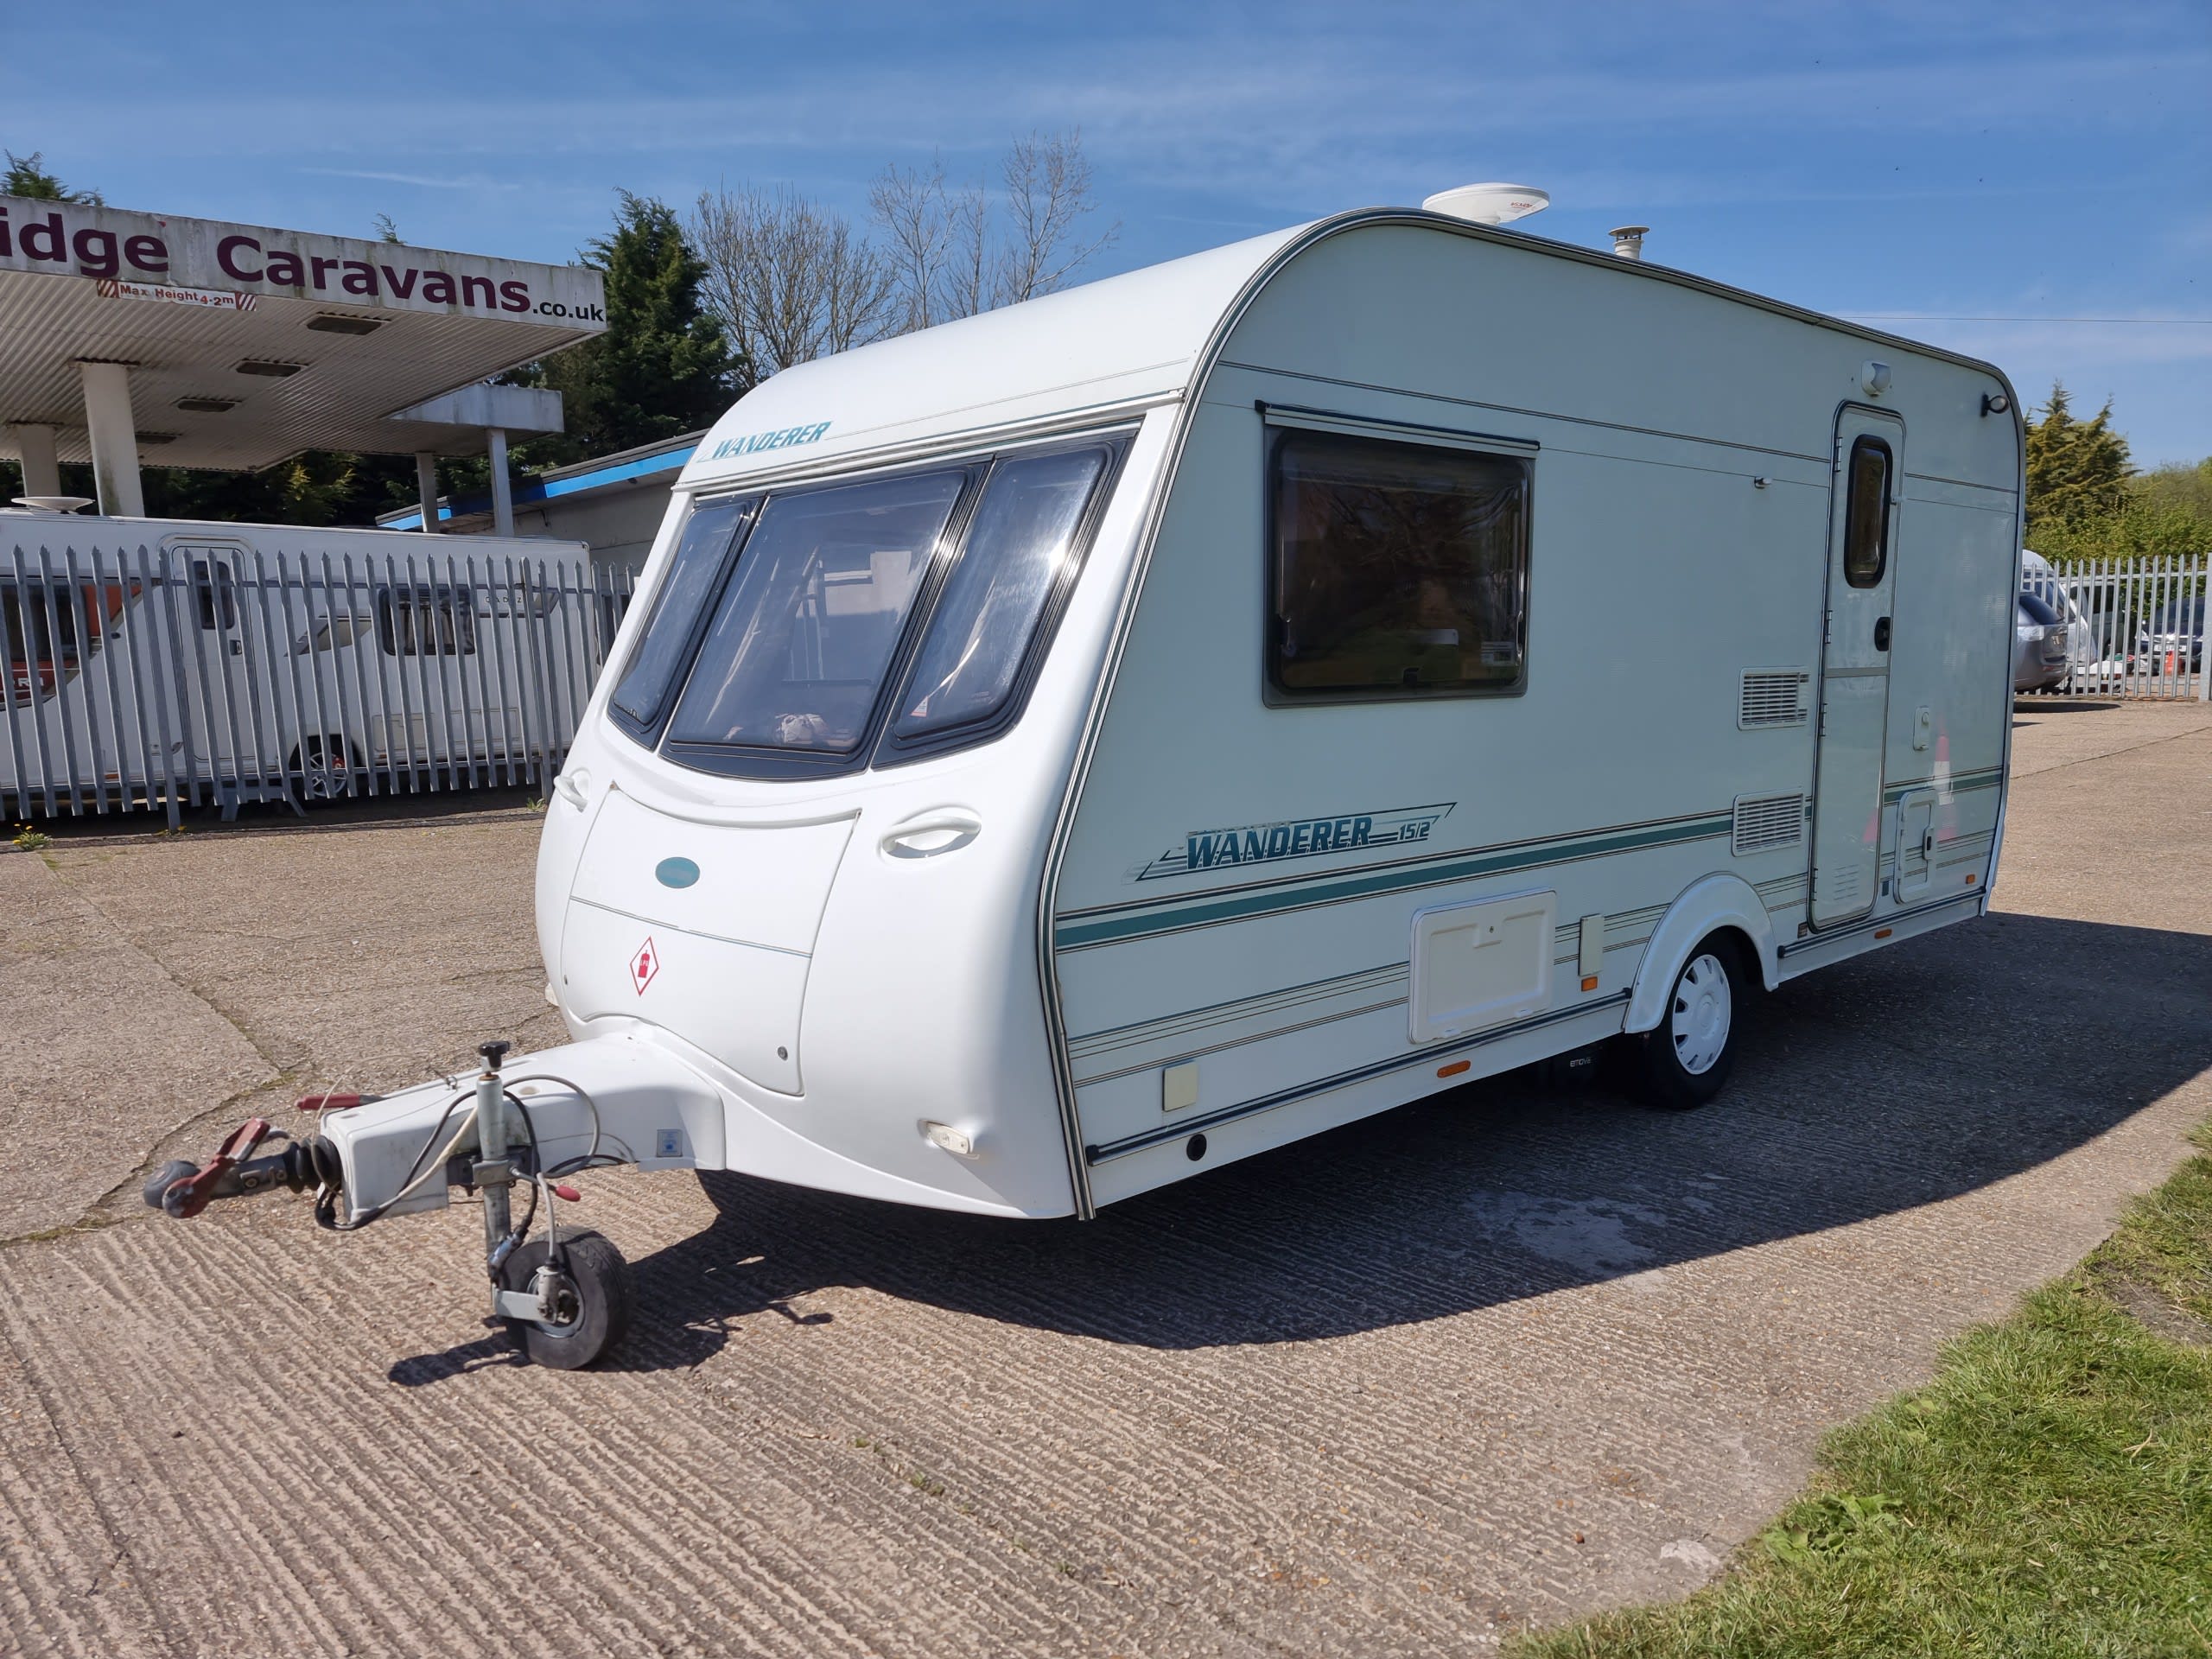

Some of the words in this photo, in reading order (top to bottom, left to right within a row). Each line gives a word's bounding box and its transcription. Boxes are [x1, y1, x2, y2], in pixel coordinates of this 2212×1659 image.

[119, 284, 148, 296] Max
[155, 288, 198, 302] Height
[711, 420, 832, 460] WANDERER
[1186, 816, 1373, 870] WANDERER
[1399, 821, 1431, 841] 15/2
